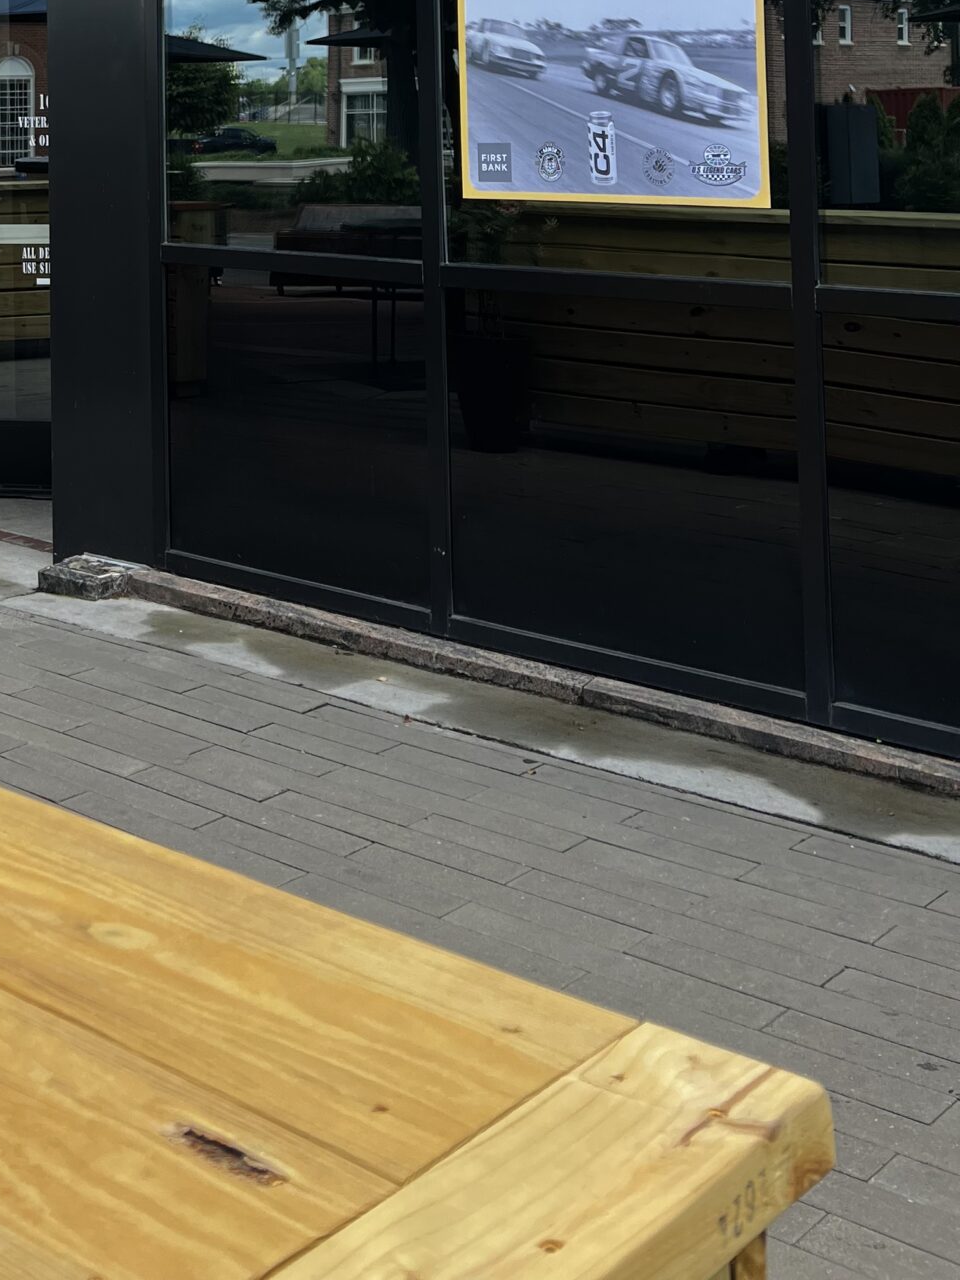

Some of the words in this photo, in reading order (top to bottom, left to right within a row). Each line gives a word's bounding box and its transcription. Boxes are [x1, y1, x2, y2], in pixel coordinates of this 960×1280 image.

[29, 134, 36, 147] &
[481, 154, 507, 162] FIRST
[592, 130, 611, 176] C4
[481, 163, 508, 172] BANK
[22, 246, 36, 259] ALL
[22, 261, 37, 274] USE
